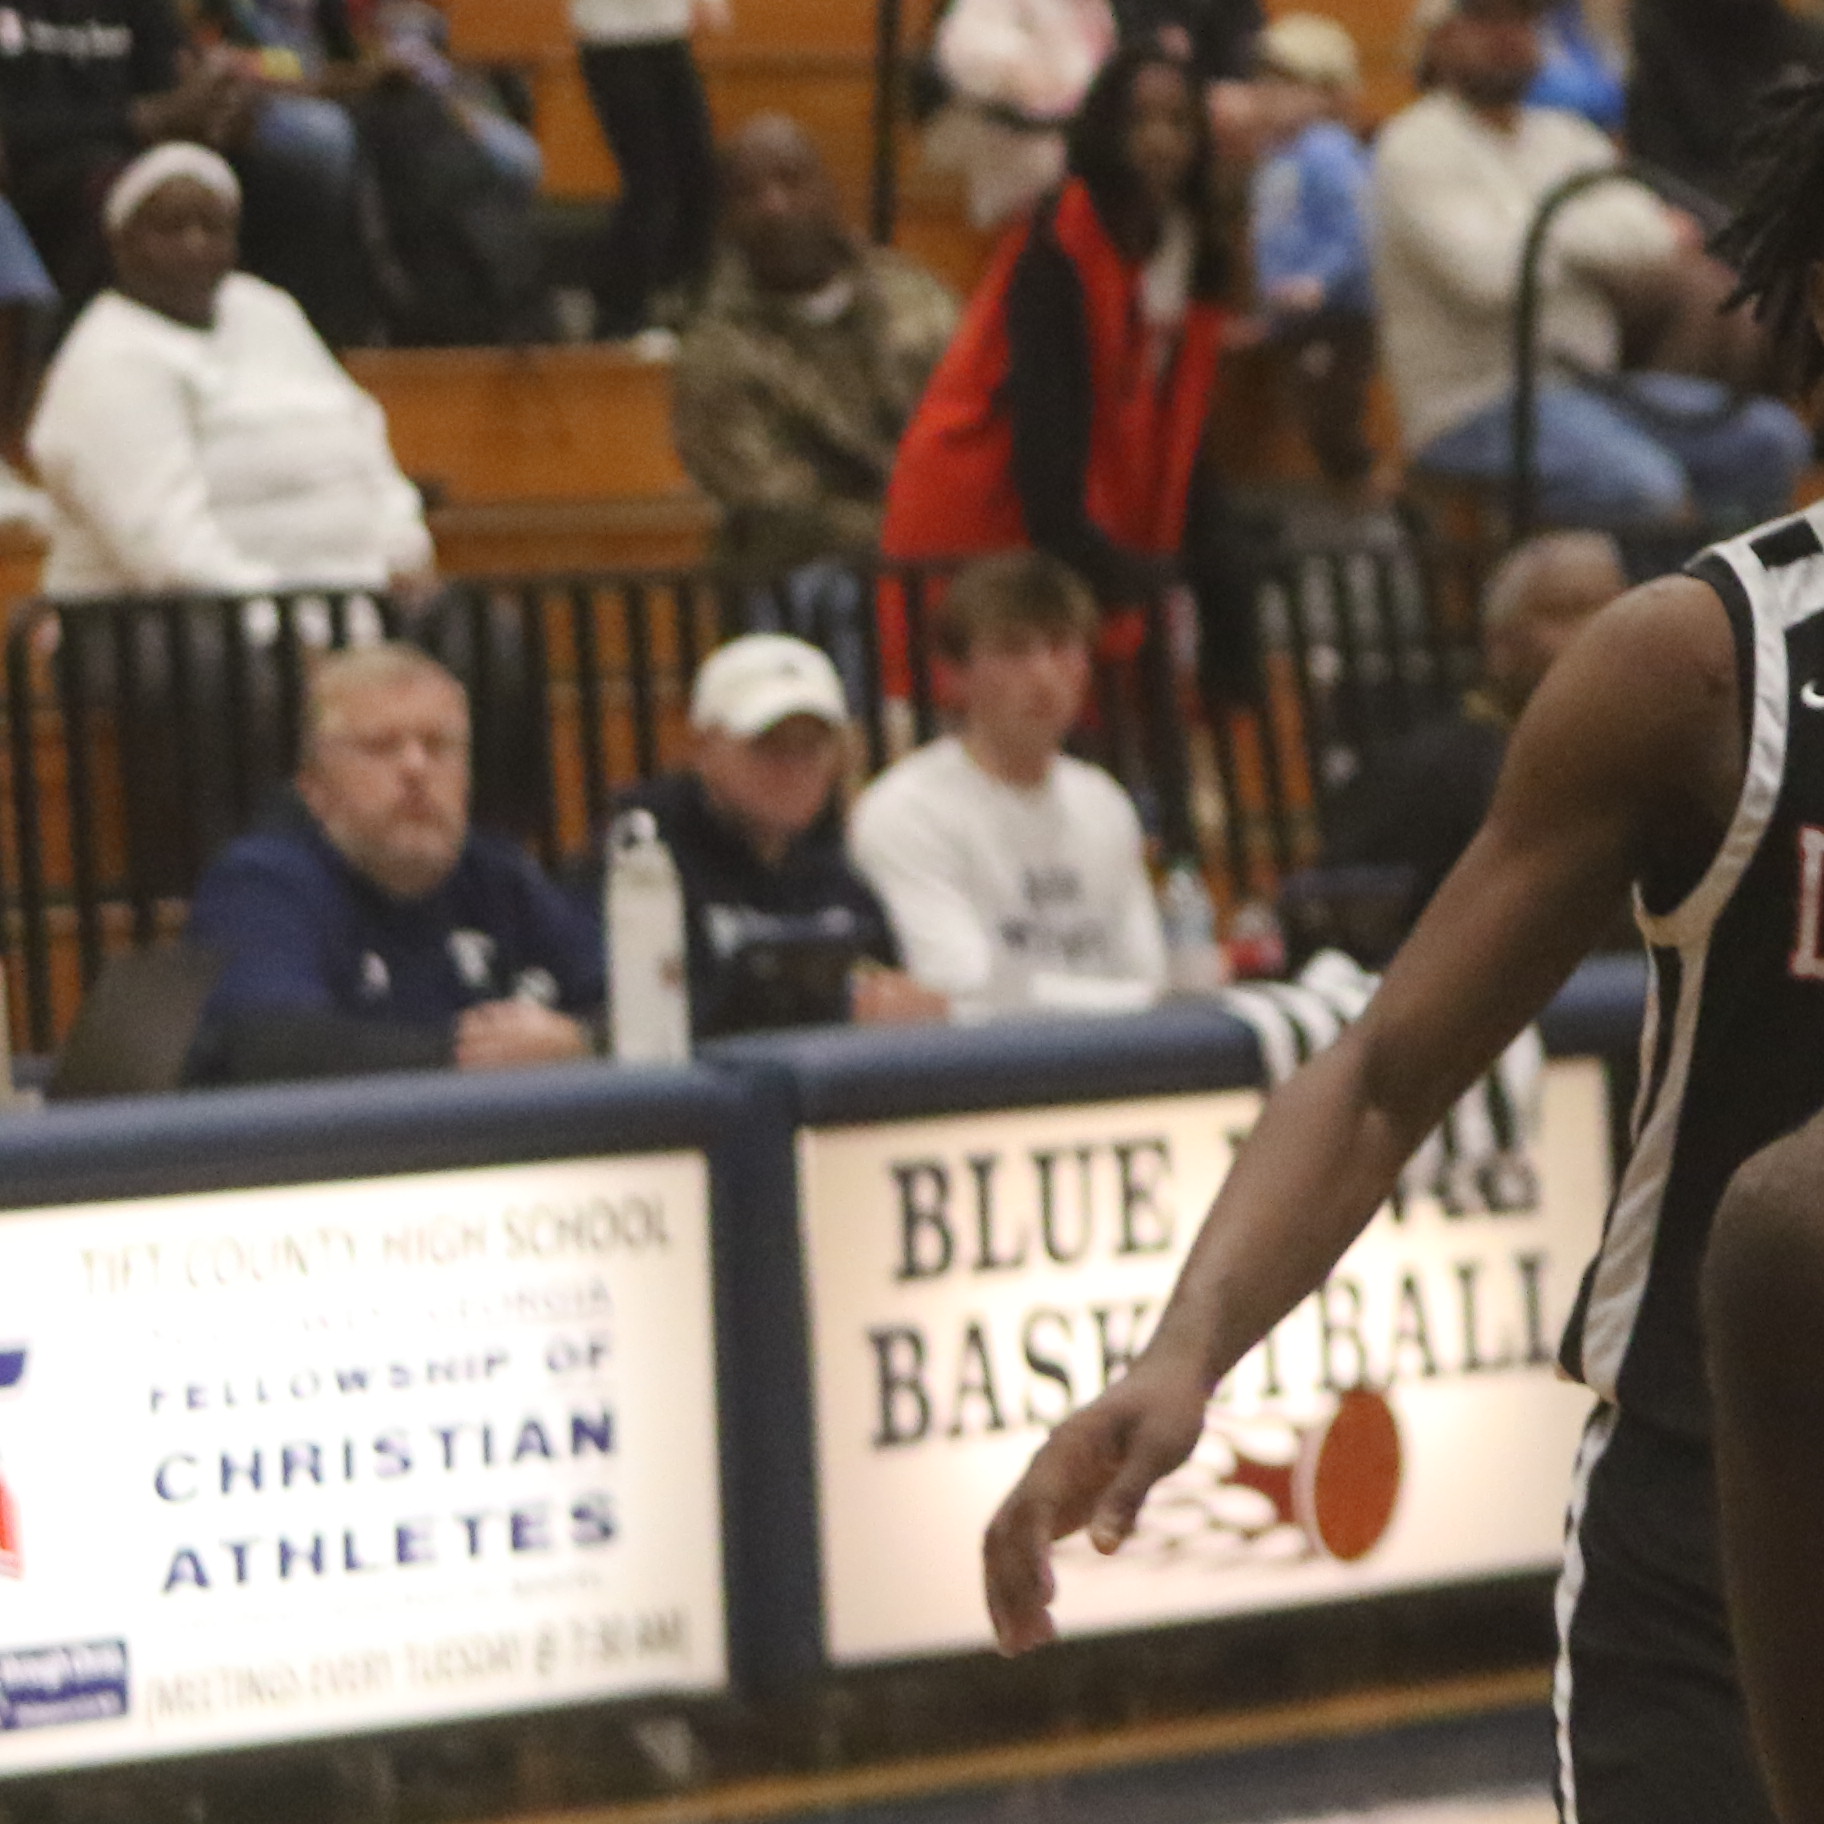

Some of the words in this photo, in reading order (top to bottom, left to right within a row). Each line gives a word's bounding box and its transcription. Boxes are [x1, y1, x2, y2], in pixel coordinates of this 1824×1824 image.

[185, 1224, 359, 1288] COUNTY
[380, 1214, 488, 1268] HIGH
[502, 1191, 672, 1261] SCHOOL
[890, 1133, 1178, 1284] BLUE
[150, 1348, 510, 1415] FELLOWSHIP
[544, 1329, 611, 1380] OF
[866, 1248, 1562, 1451] BASKBALL
[153, 1408, 617, 1503] CHRISTIAN
[161, 1492, 619, 1594] ATHLETES
